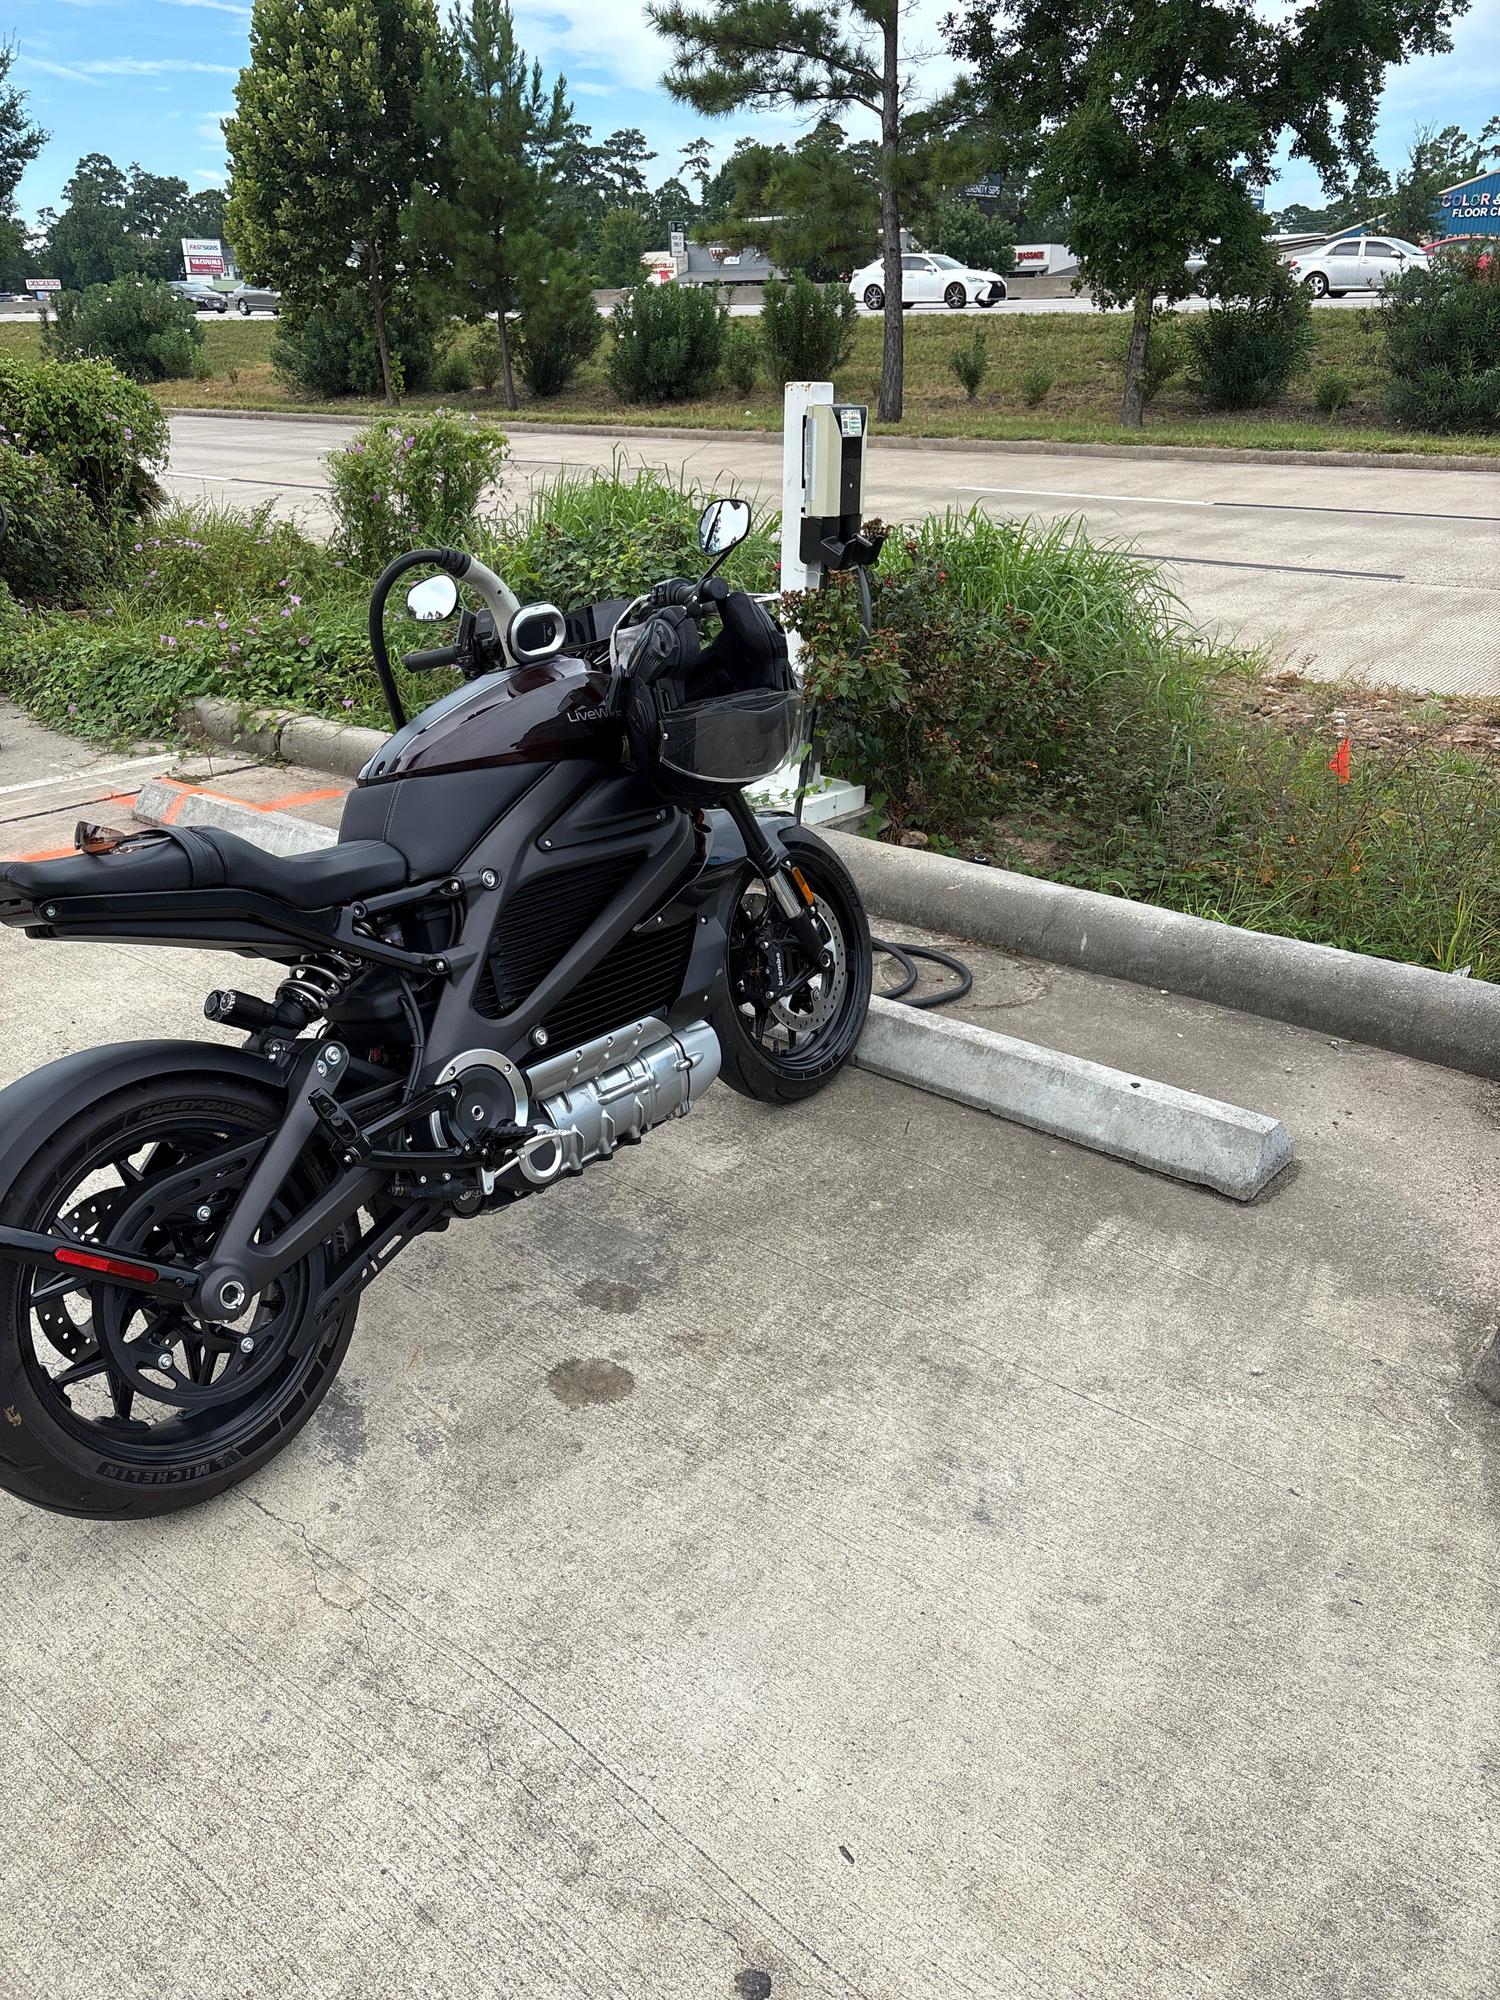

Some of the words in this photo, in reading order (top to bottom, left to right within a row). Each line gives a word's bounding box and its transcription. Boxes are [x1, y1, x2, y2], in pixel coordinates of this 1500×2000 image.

[1441, 193, 1490, 207] COLOR
[1452, 207, 1488, 218] FLOOR
[775, 952, 784, 986] brembo
[104, 1462, 211, 1484] MICHELIN
